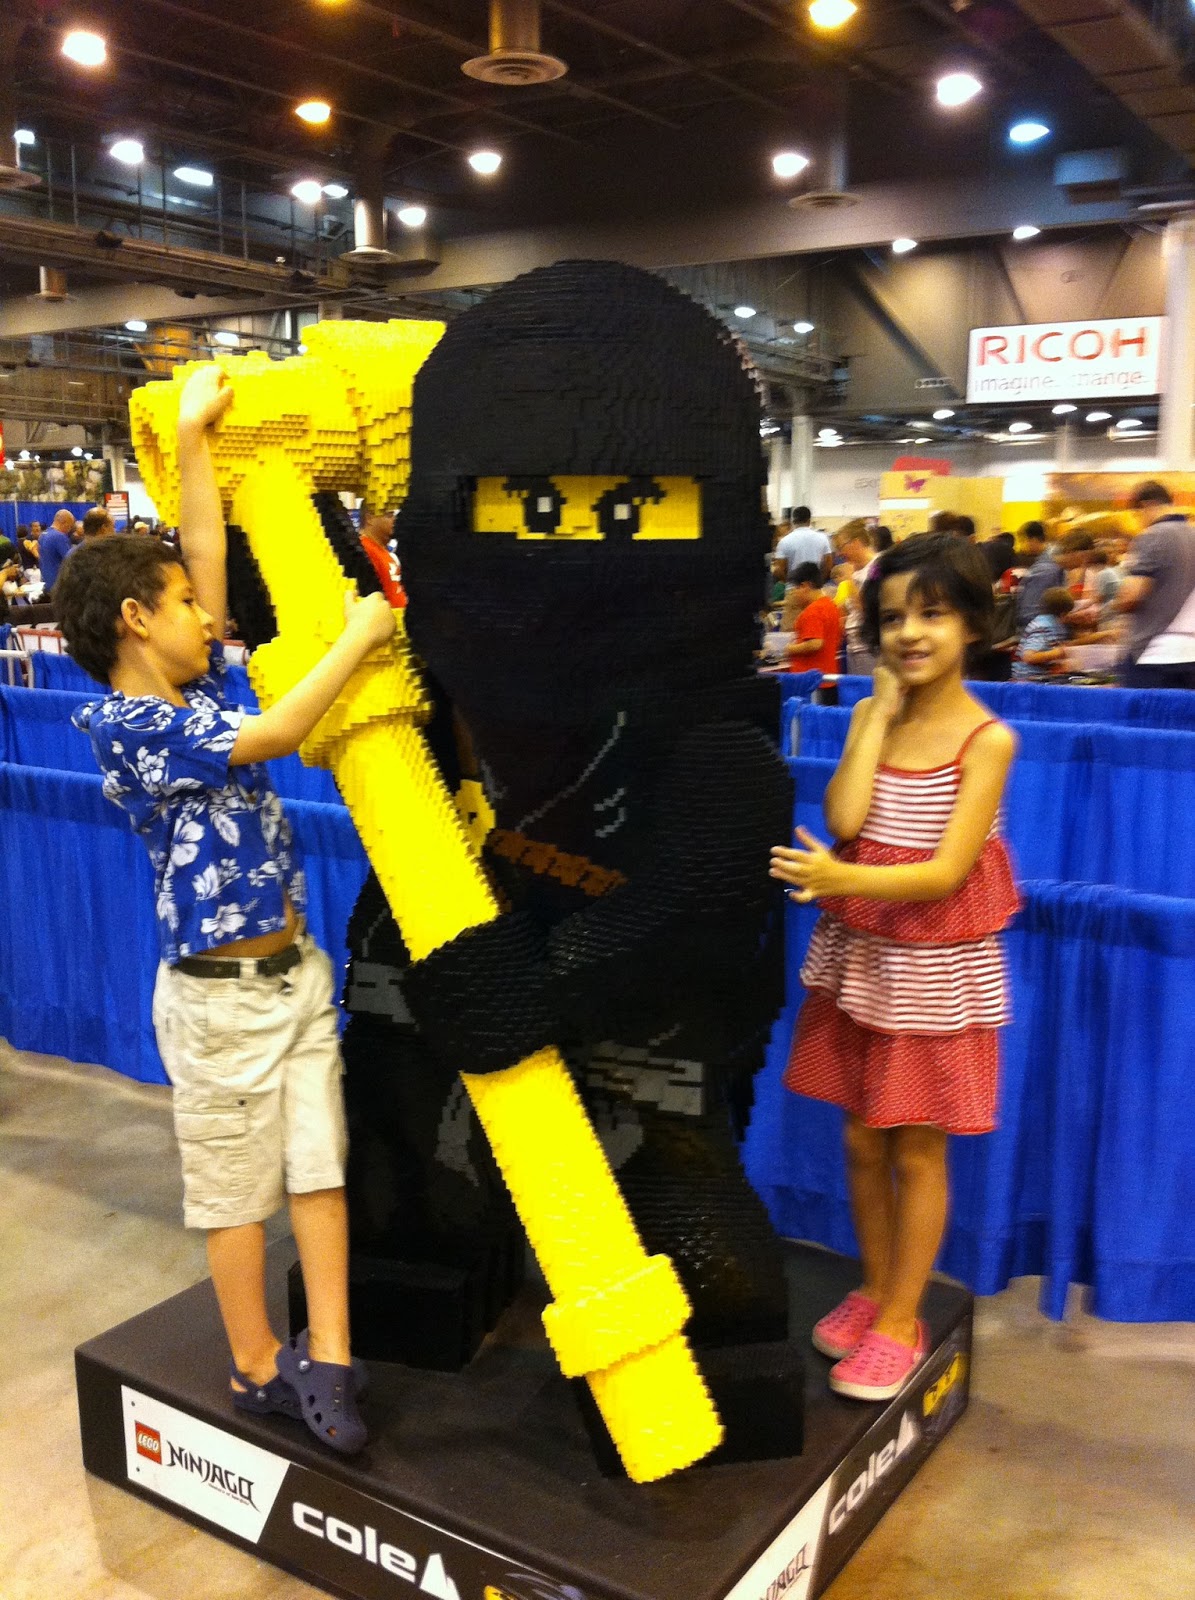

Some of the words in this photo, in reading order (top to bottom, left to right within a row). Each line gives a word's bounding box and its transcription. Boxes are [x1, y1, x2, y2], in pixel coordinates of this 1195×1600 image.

[976, 326, 1148, 366] RICOH
[137, 1432, 160, 1453] LEGO
[165, 1440, 261, 1512] NINJAGO
[828, 1438, 896, 1535] cole
[292, 1501, 417, 1584] cole
